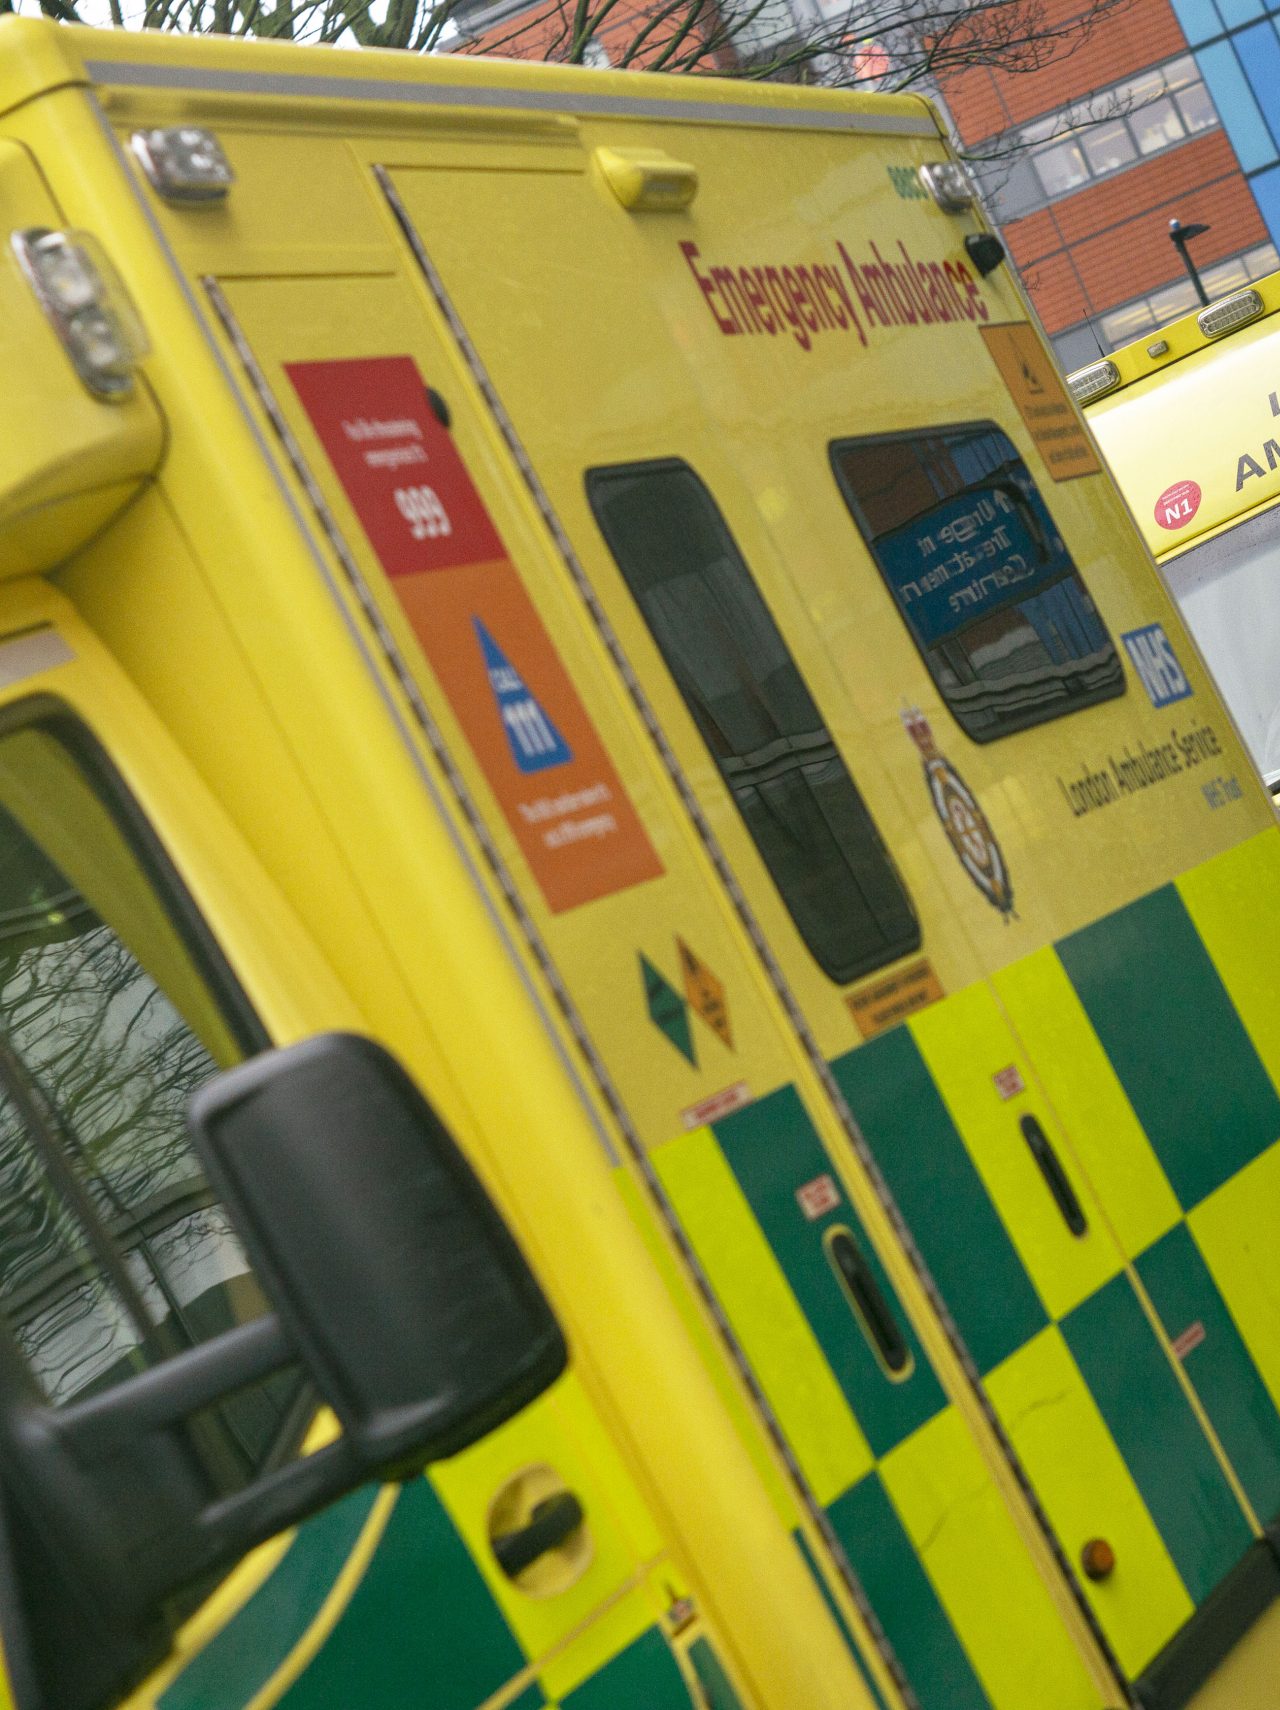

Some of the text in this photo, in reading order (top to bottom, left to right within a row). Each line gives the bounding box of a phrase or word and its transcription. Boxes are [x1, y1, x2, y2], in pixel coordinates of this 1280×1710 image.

[678, 239, 989, 351] Emergency Ambulance
[393, 485, 452, 539] 999
[1165, 498, 1193, 524] N1
[1124, 626, 1188, 702] NHS
[503, 698, 557, 757] 111
[1056, 719, 1223, 817] London Ambulance Service
